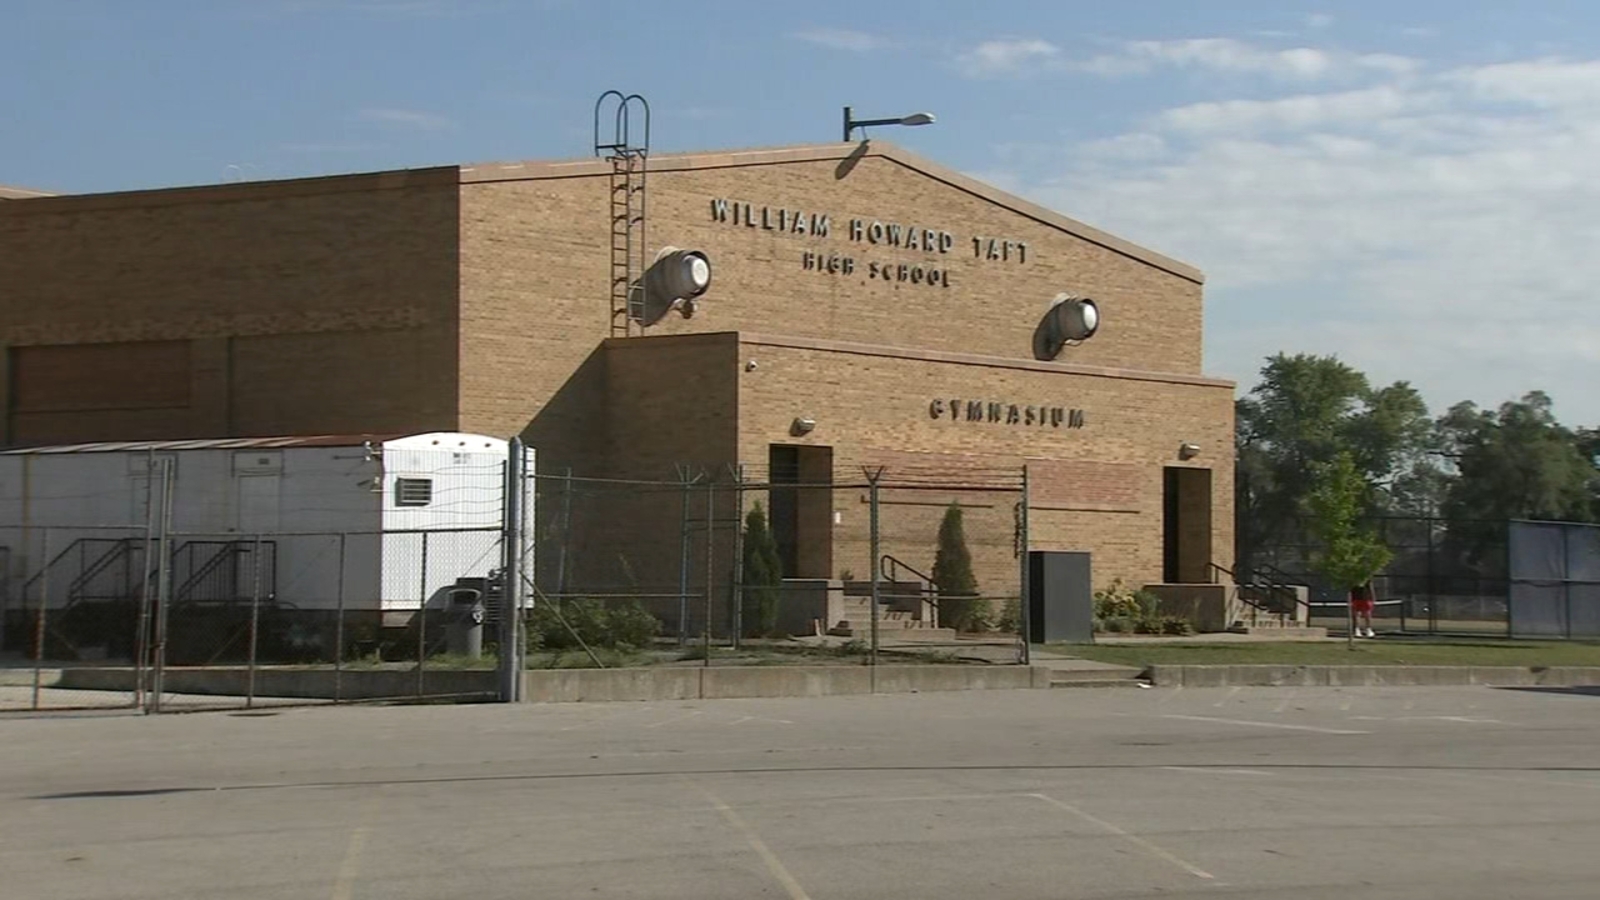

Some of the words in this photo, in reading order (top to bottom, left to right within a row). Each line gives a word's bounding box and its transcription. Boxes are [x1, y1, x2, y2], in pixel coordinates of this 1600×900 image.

[710, 198, 831, 238] WILLIAM
[850, 217, 952, 254] HOWARD
[972, 235, 1029, 264] TAFT
[803, 251, 854, 276] HIGH
[869, 260, 950, 288] SCHOOL
[929, 398, 1084, 430] GYMNASIUM
